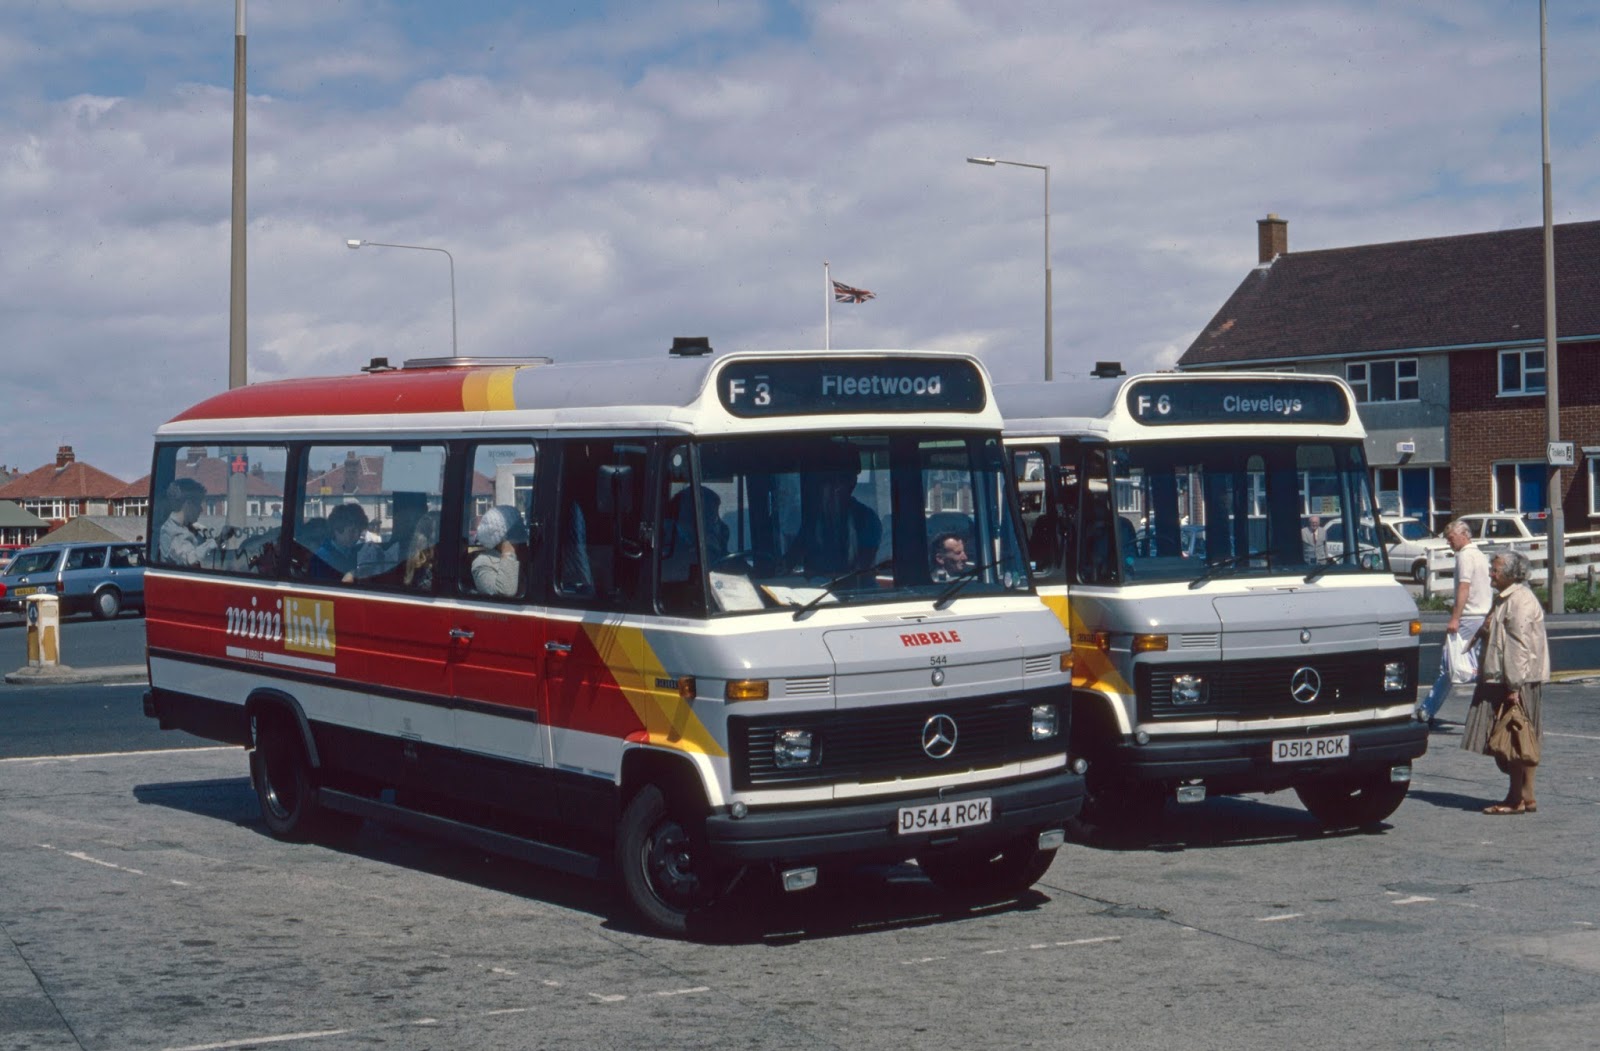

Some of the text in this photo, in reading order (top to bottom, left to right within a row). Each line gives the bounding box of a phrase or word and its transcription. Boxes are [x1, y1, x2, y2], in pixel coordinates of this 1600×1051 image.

[729, 378, 771, 405] F 3
[821, 375, 942, 395] Fleetwood
[1138, 394, 1171, 415] F 6
[1222, 395, 1302, 415] Cleveleys
[900, 629, 961, 647] RIBBLE
[930, 655, 947, 666] 544
[1278, 739, 1344, 759] D512 RCK
[902, 801, 988, 830] D544 RCK
